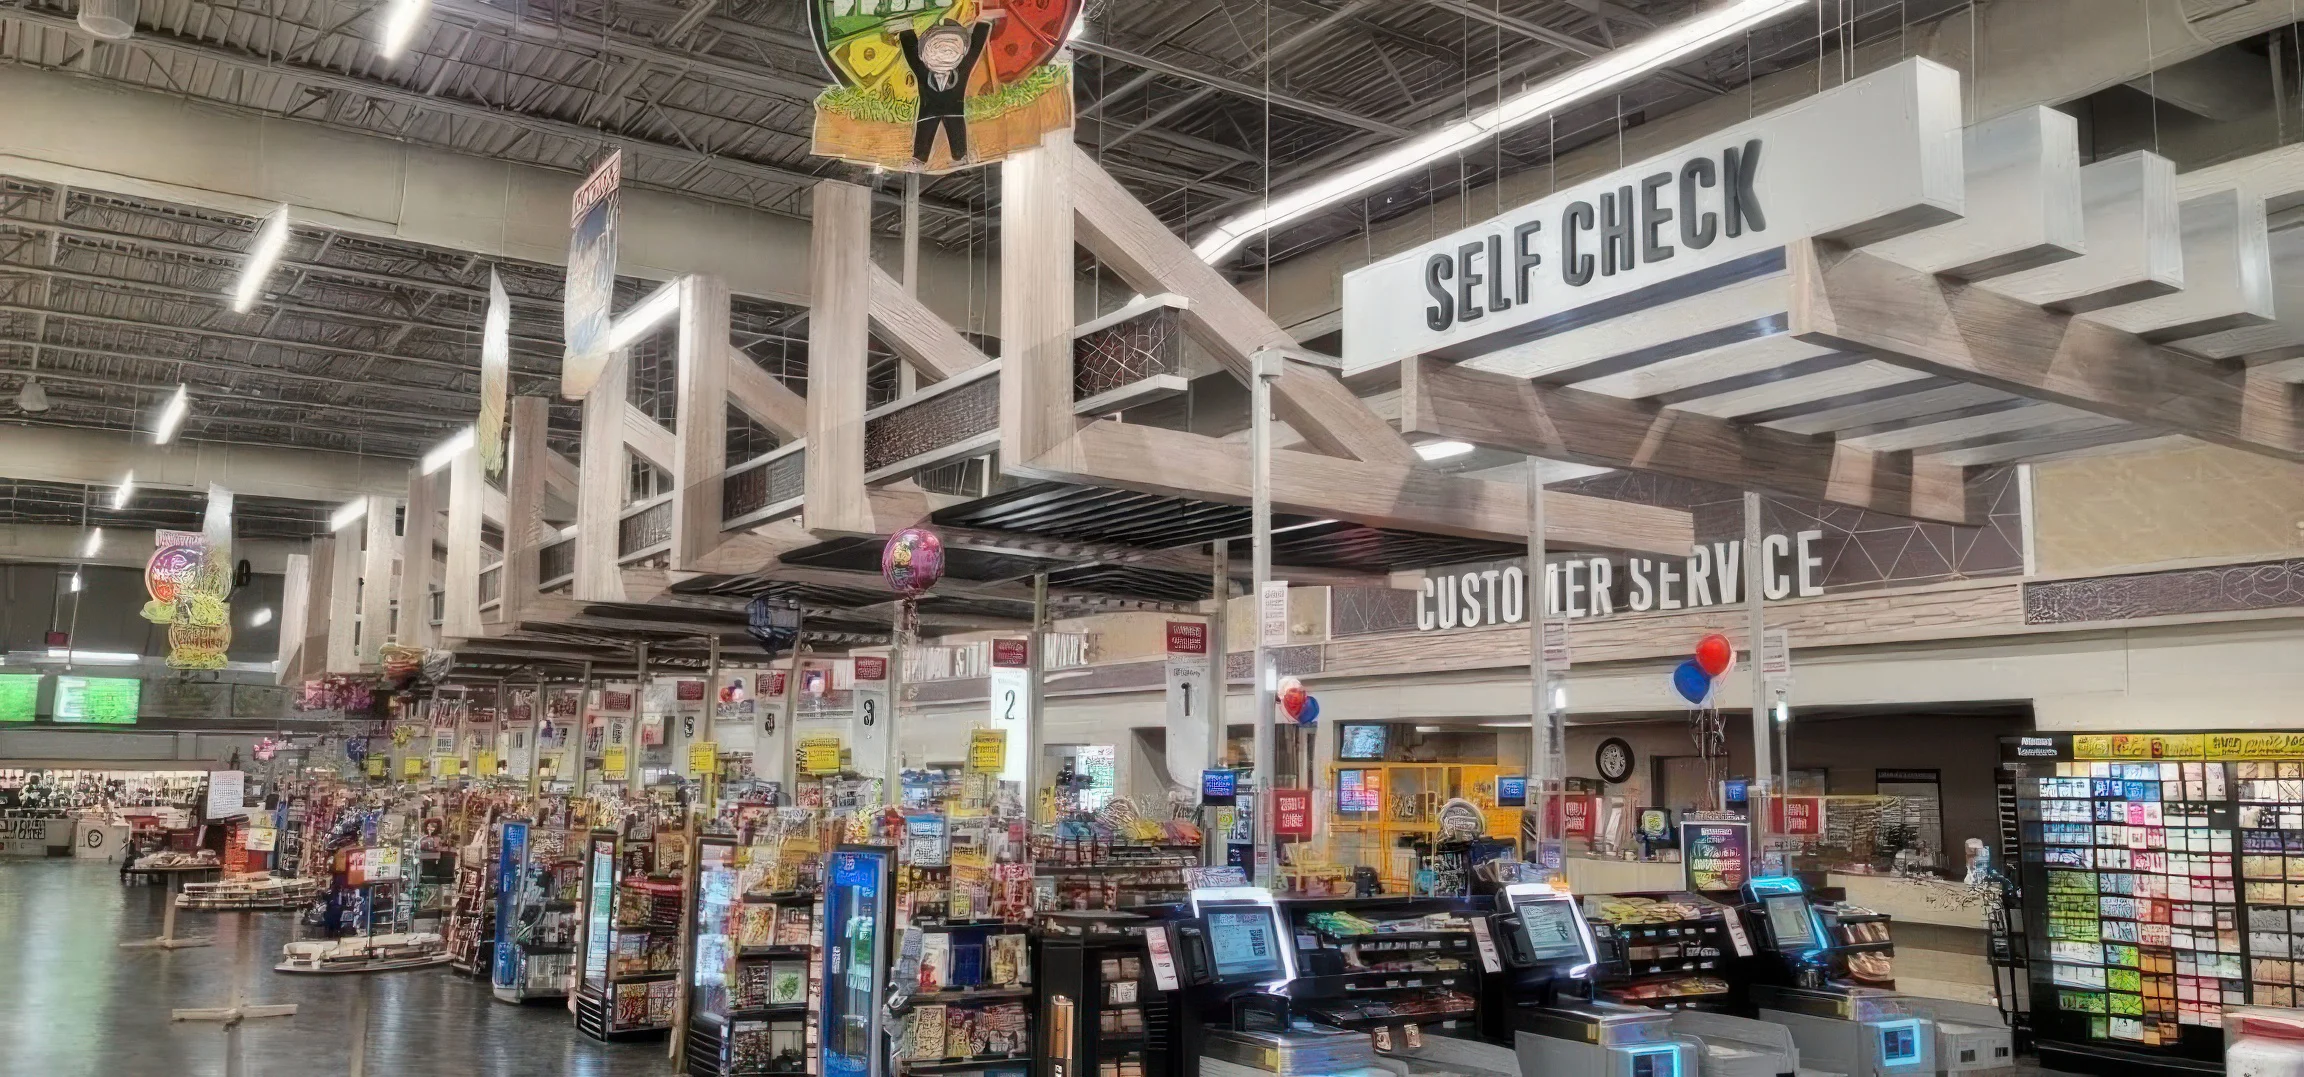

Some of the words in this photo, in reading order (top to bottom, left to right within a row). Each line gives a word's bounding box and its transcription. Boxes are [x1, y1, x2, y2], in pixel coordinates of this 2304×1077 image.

[1425, 219, 1541, 332] SELF
[1561, 139, 1766, 287] CHECK
[1630, 530, 1825, 612] SERVCE
[1004, 689, 1016, 720] 2
[1181, 682, 1191, 717] 1
